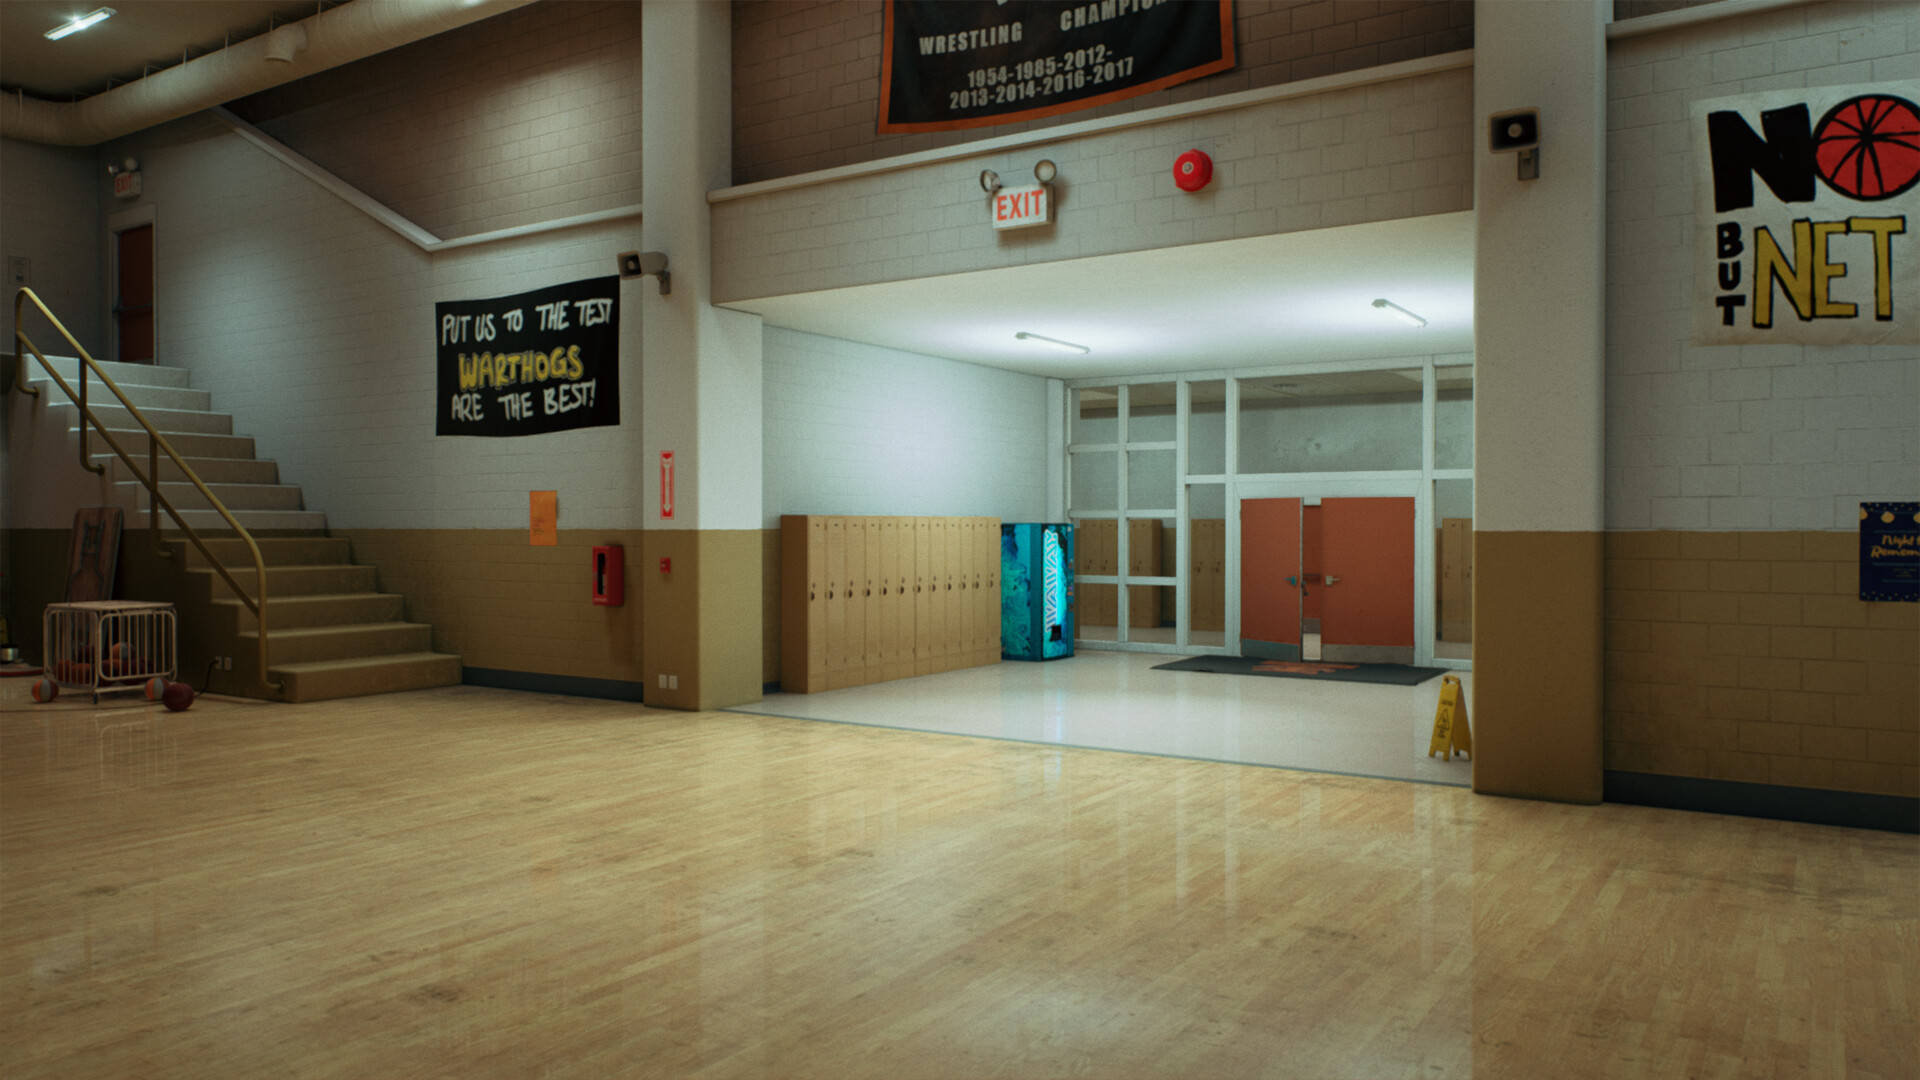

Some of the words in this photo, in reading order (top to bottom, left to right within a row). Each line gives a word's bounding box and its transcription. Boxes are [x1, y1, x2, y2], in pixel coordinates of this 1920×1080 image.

[1060, 0, 1168, 32] CHAMPI
[918, 22, 1023, 56] WRESTLING
[949, 56, 1135, 110] 2013-2014-2016-2017
[967, 43, 1113, 88] 1954-1985-2012-
[996, 189, 1044, 221] EXIT
[1716, 221, 1746, 326] BUT
[1752, 215, 1906, 329] NET
[442, 314, 471, 346] PUT
[474, 314, 497, 342] US
[502, 309, 524, 332] TO
[535, 301, 570, 332] THE
[574, 298, 614, 327] TEST
[458, 345, 584, 391] WARTHOGS
[451, 394, 485, 422] ARE
[497, 392, 535, 421] THE
[542, 378, 597, 415] BEST!
